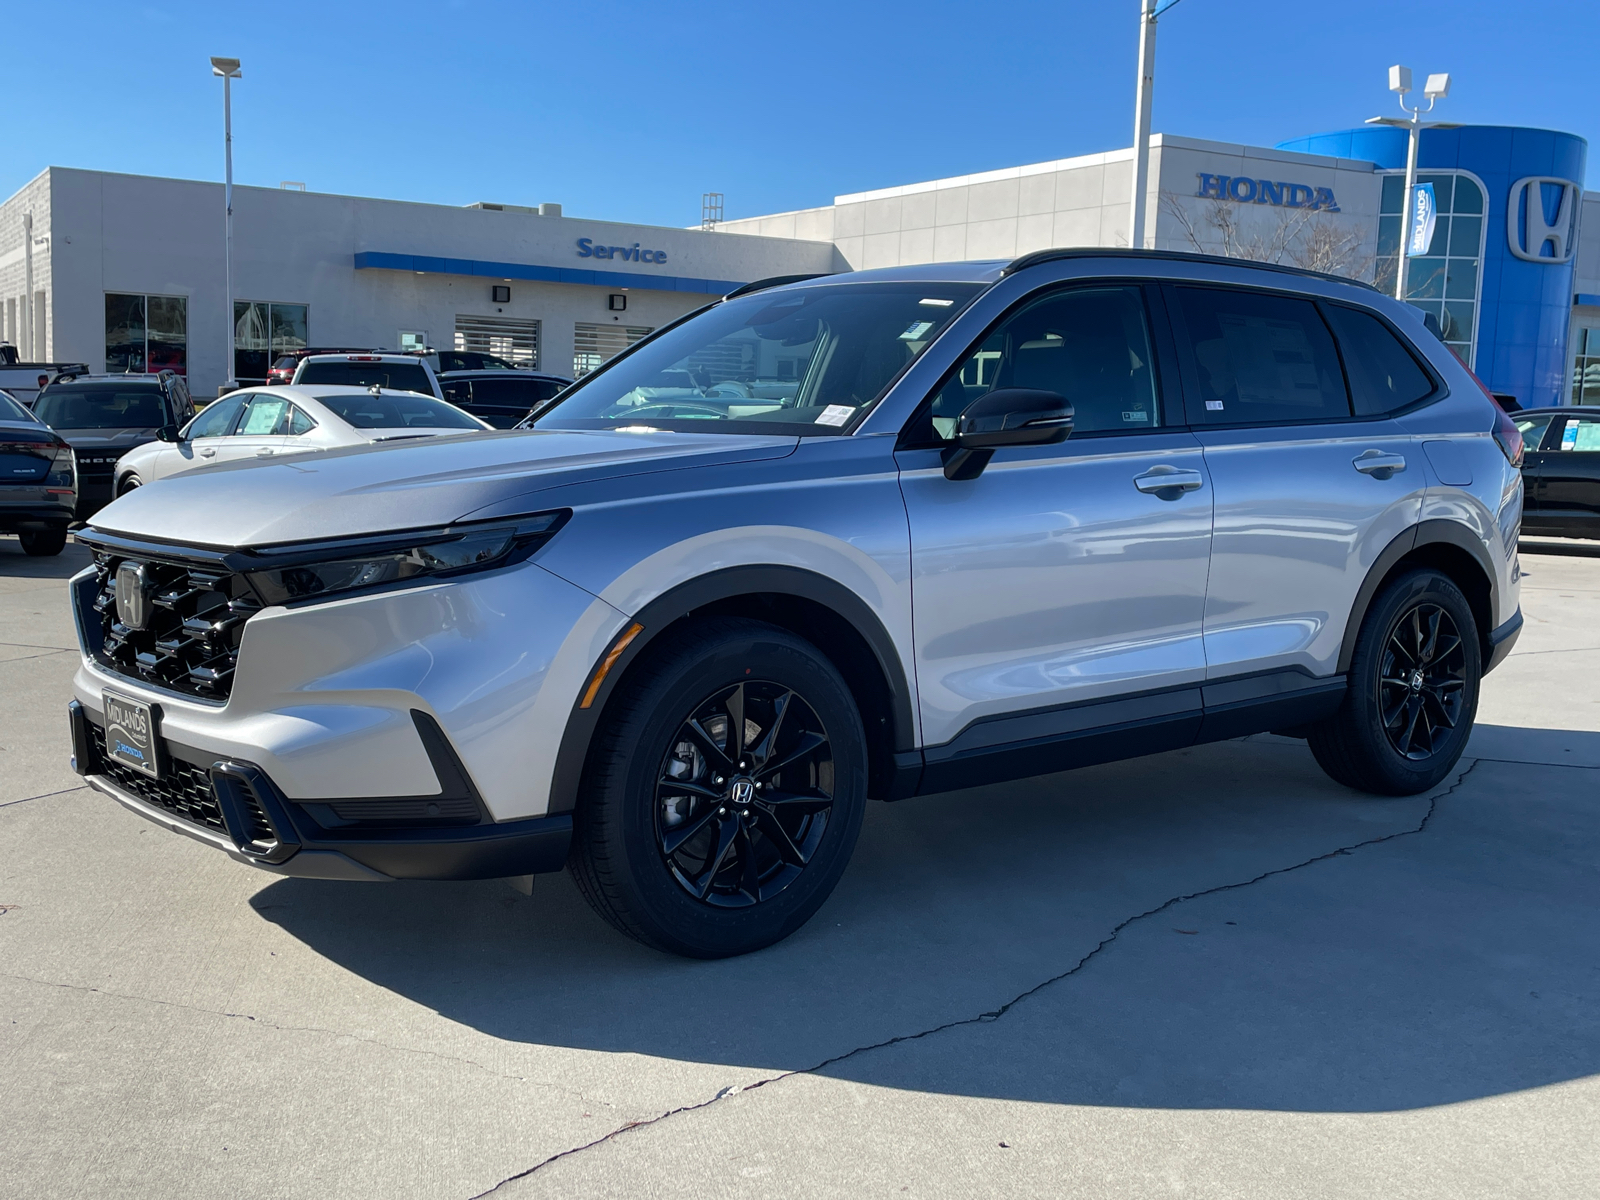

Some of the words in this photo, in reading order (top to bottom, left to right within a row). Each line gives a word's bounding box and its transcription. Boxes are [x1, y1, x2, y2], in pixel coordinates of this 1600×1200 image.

[1197, 172, 1341, 213] HONDA
[1413, 189, 1426, 252] MIDLANDS
[577, 238, 667, 264] Service
[107, 703, 146, 733] MIDLANDS
[120, 742, 145, 760] HONDA
